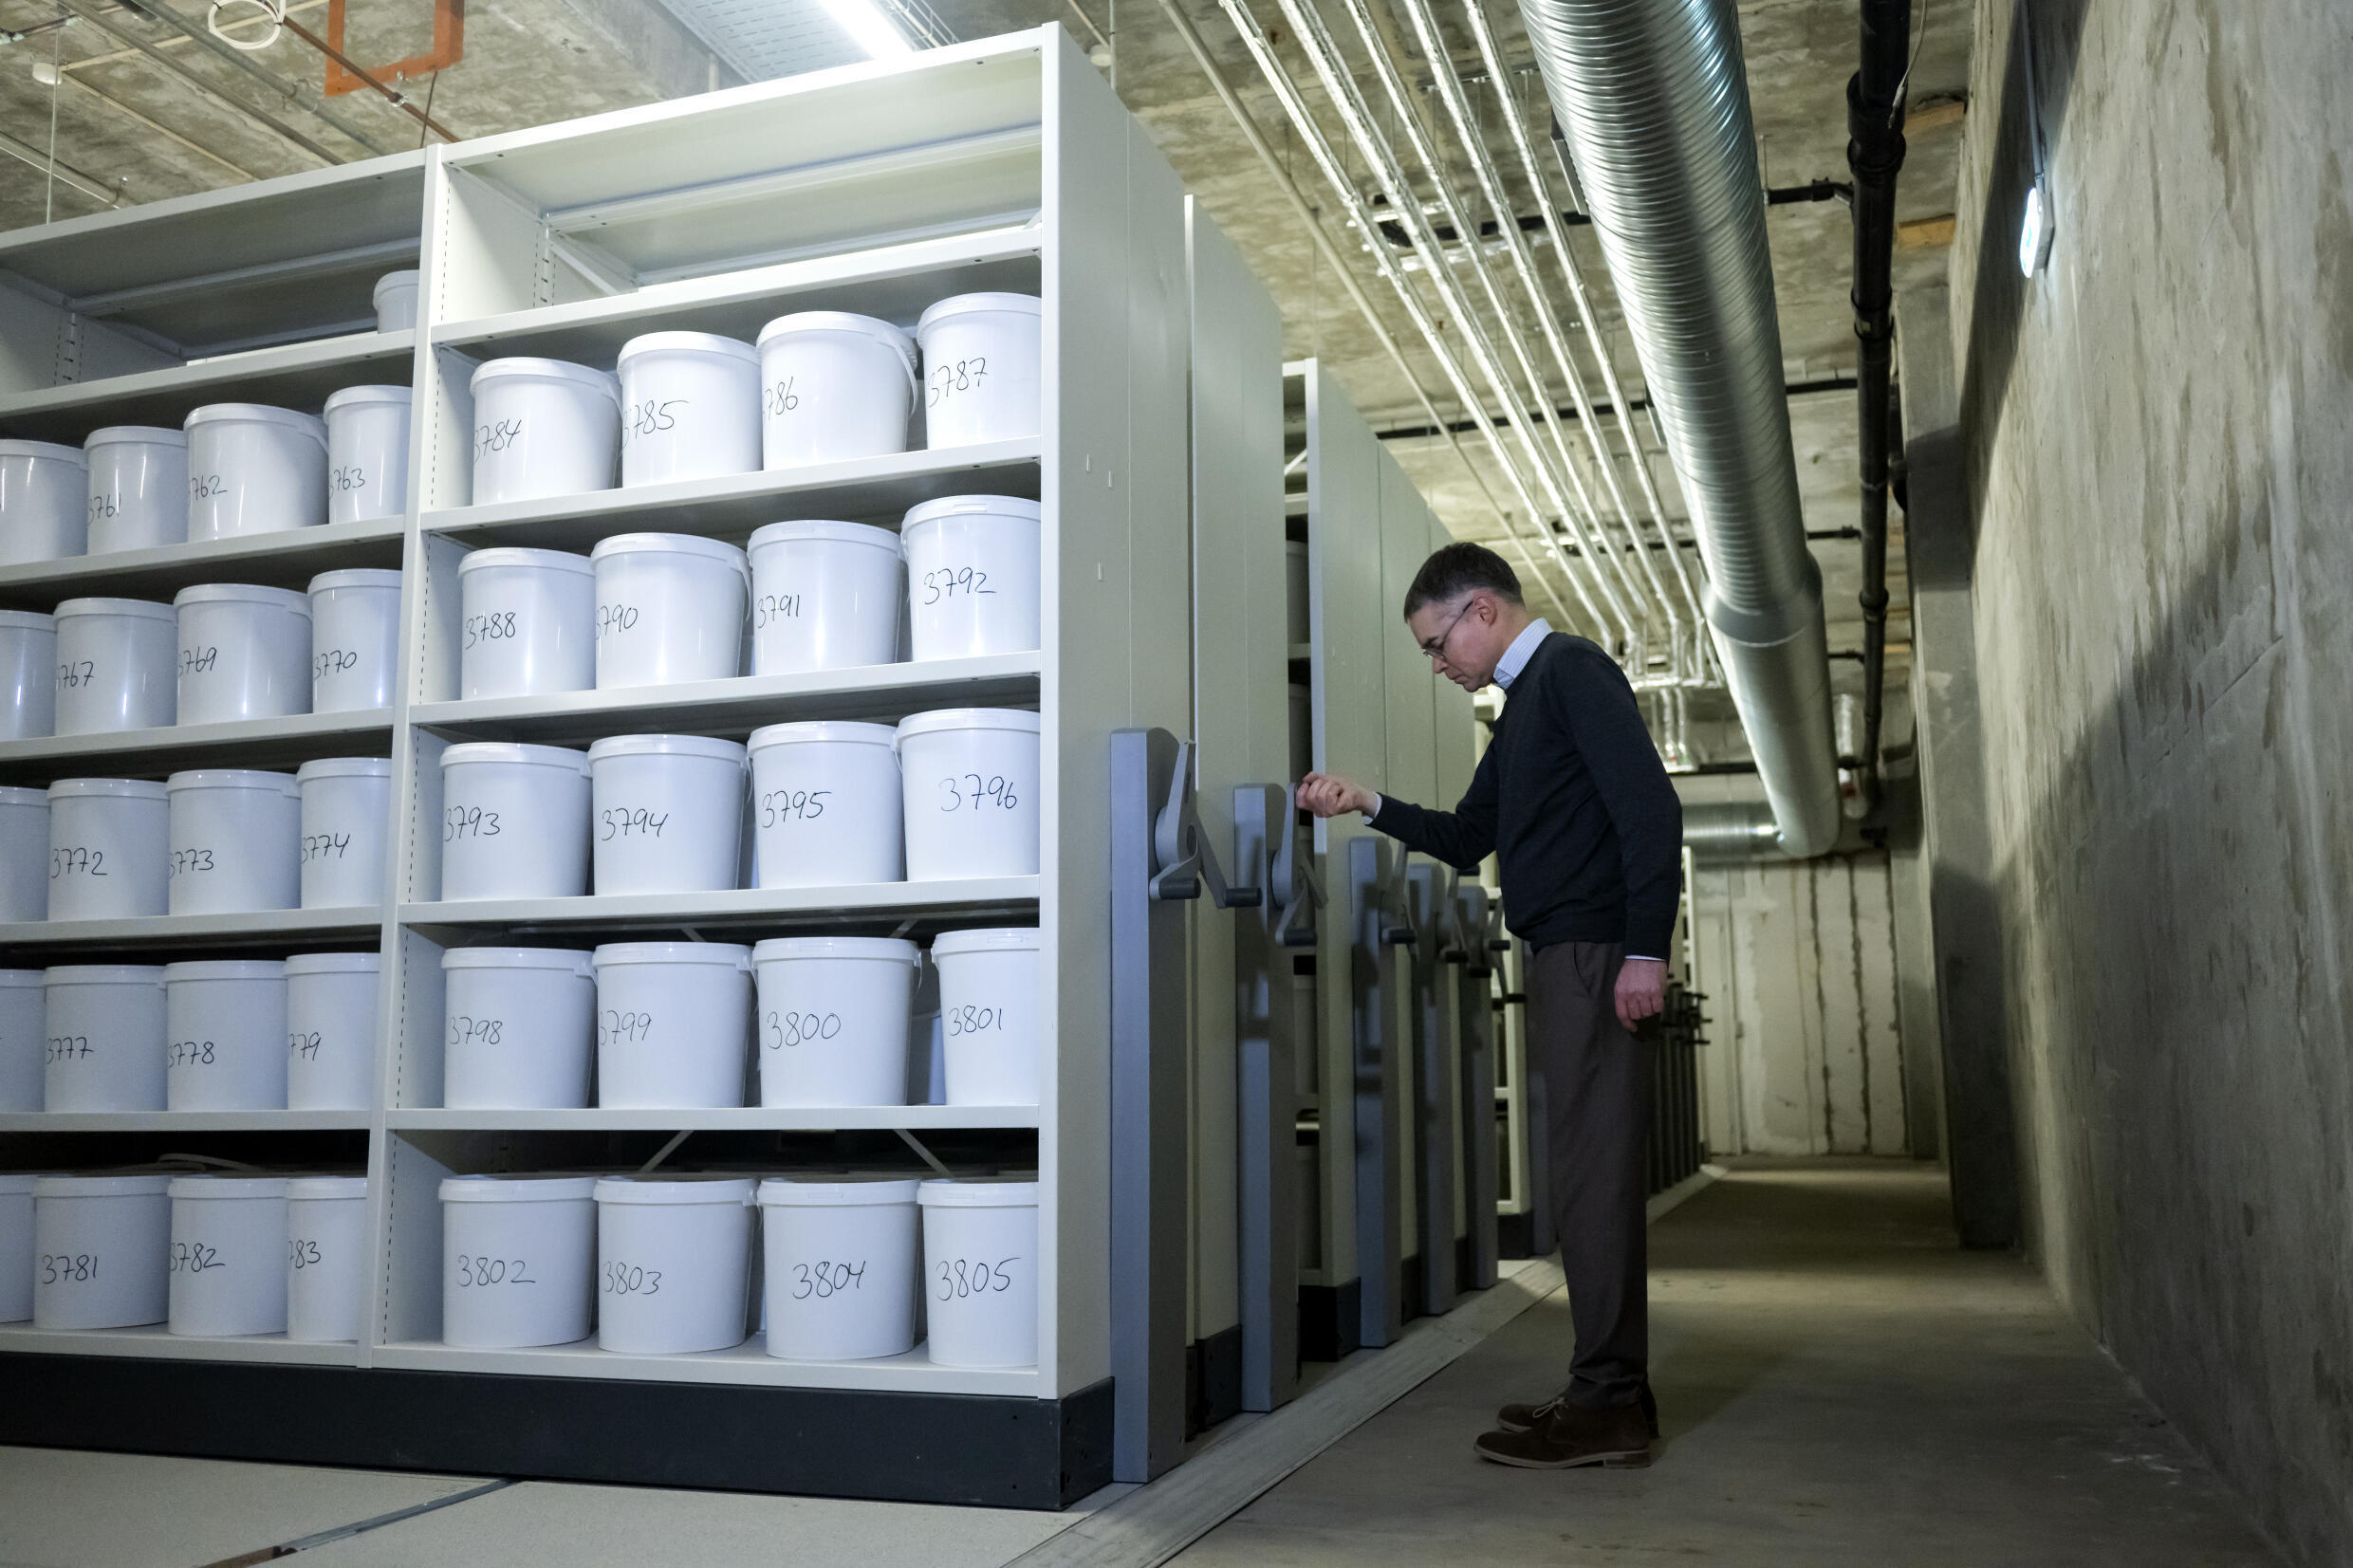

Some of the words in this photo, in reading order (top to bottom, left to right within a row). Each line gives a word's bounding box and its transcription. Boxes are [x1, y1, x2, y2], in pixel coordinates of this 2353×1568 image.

[928, 357, 988, 408] 3787
[923, 566, 997, 605] 3792
[757, 594, 800, 629] 3791
[465, 611, 516, 650] 3788
[313, 650, 358, 680] 3770
[762, 790, 832, 829] 3795
[937, 774, 1017, 812] 3796
[444, 804, 501, 842] 3793
[601, 807, 668, 841] 3794
[51, 848, 108, 878] 3772
[449, 1016, 503, 1045] 3798
[767, 1011, 841, 1049] 3800
[948, 1005, 1002, 1036] 3801
[46, 1037, 93, 1064] 3777
[42, 1254, 98, 1284] 3781
[456, 1254, 536, 1287] 3802
[603, 1262, 662, 1295] 3803
[792, 1261, 866, 1300] 3804
[935, 1257, 1021, 1301] 3805
